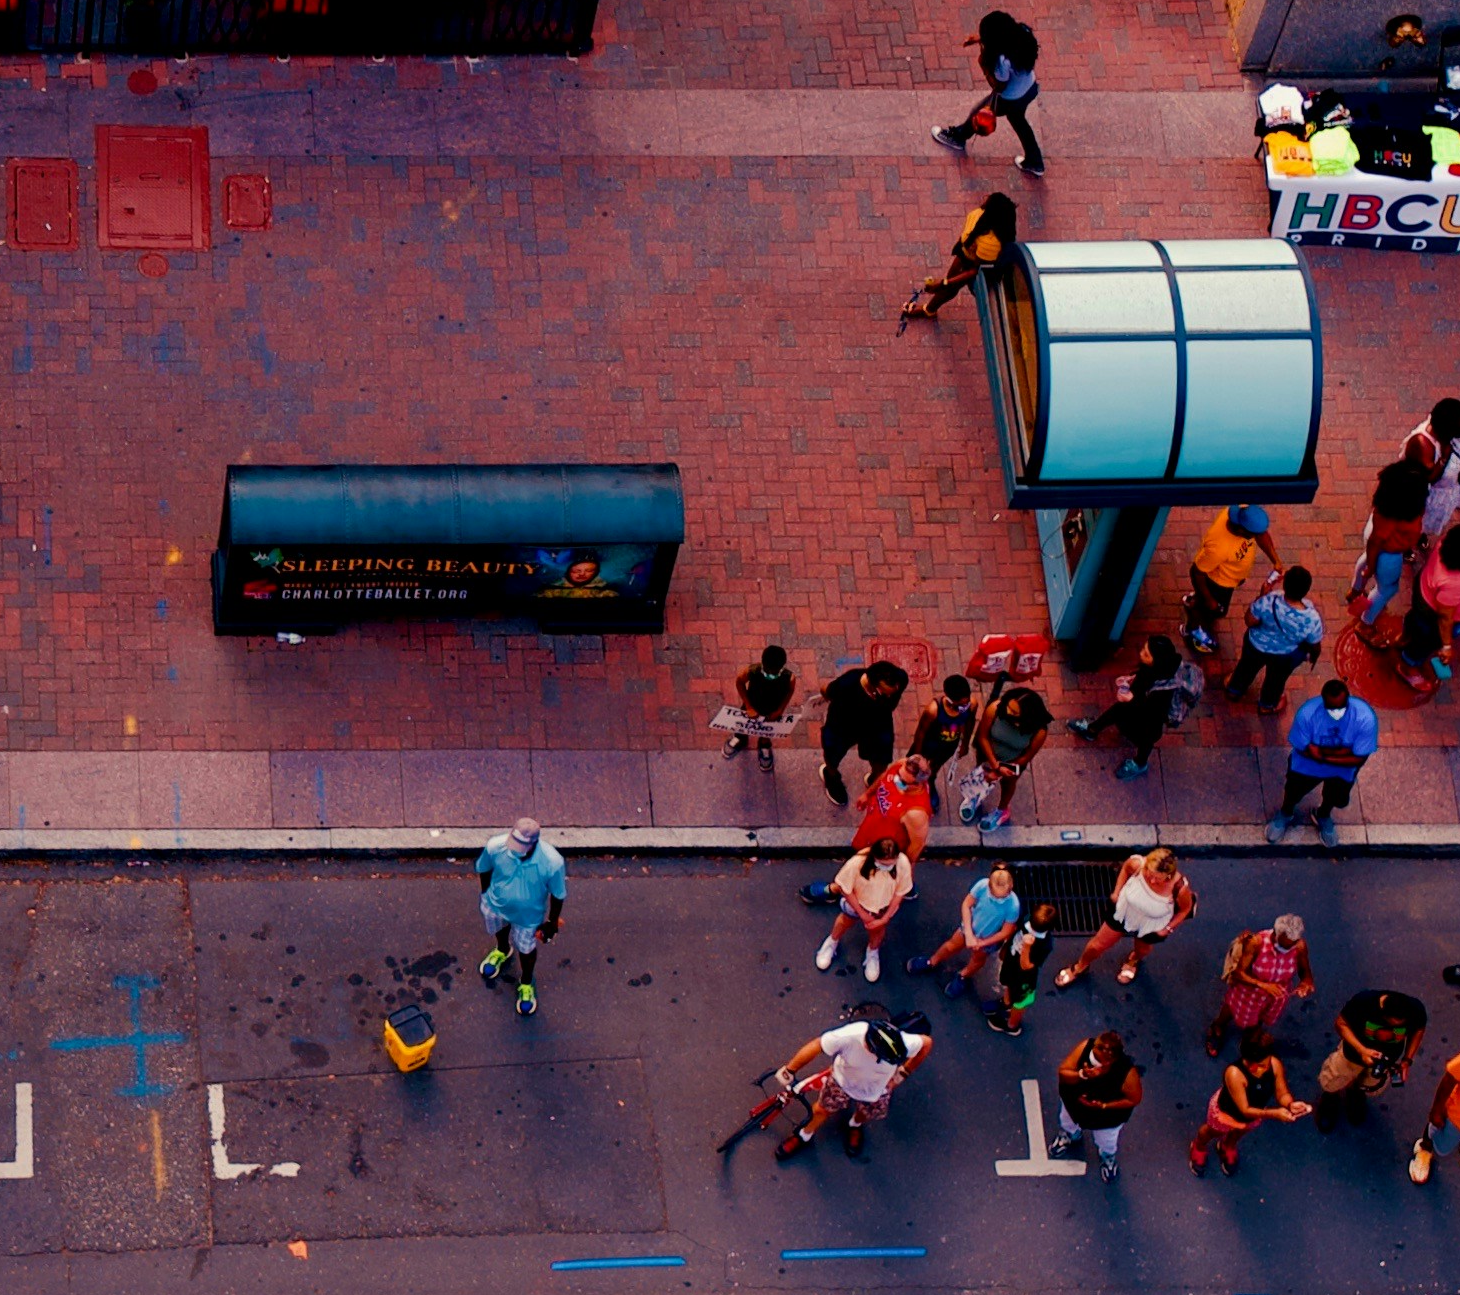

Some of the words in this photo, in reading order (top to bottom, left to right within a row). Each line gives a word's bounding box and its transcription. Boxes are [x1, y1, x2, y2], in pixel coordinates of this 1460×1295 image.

[282, 557, 416, 573] SLEEPING
[426, 559, 542, 576] BEAUTY
[282, 588, 469, 600] CHARLOTTEBALLET.ORG
